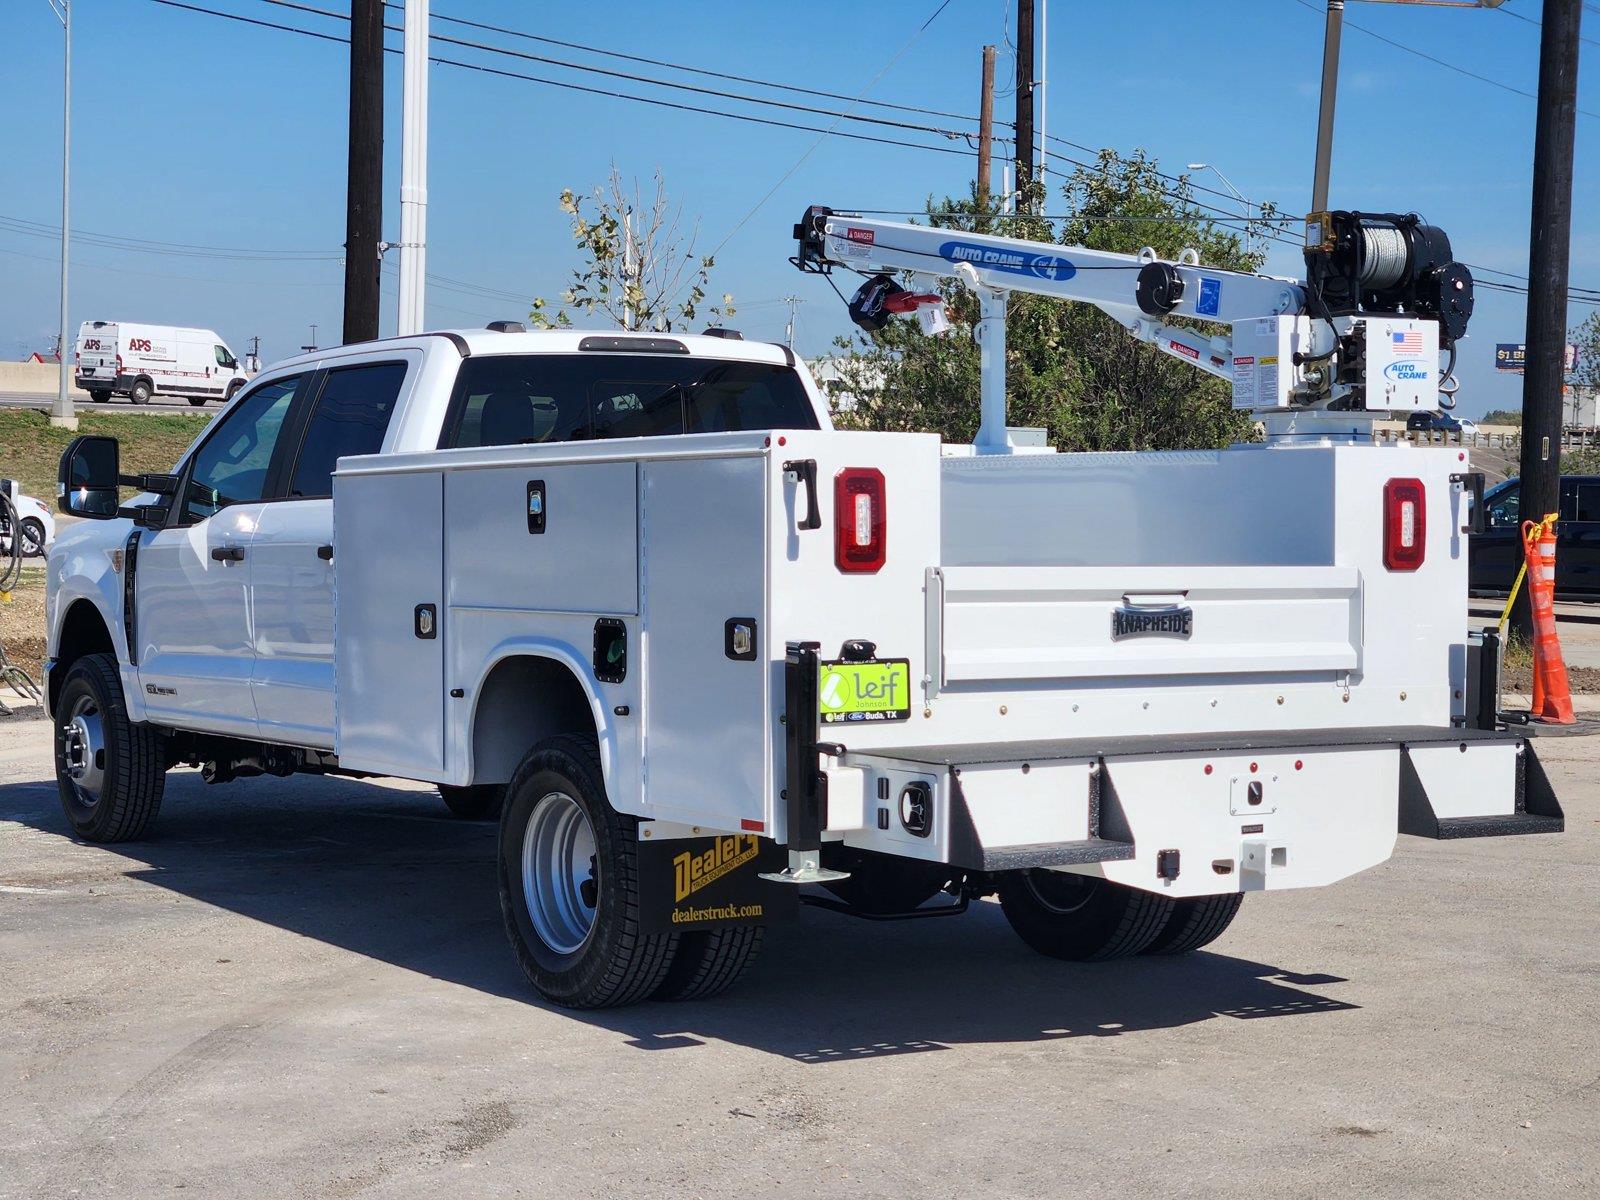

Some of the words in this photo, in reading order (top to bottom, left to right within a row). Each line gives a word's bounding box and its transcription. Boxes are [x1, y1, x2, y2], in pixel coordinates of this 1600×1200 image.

[853, 231, 873, 240] DANGER
[951, 246, 982, 262] AUTO
[983, 250, 1024, 270] CRANE
[84, 339, 101, 351] APS
[128, 338, 152, 352] APS
[1177, 344, 1198, 358] DANGER
[1513, 351, 1525, 359] BI
[1114, 608, 1190, 636] KNAPHEIDE
[887, 711, 897, 719] TX
[673, 833, 760, 903] Dealers
[708, 861, 735, 880] EQUIPMENT
[672, 903, 763, 923] dealerstruck.com
